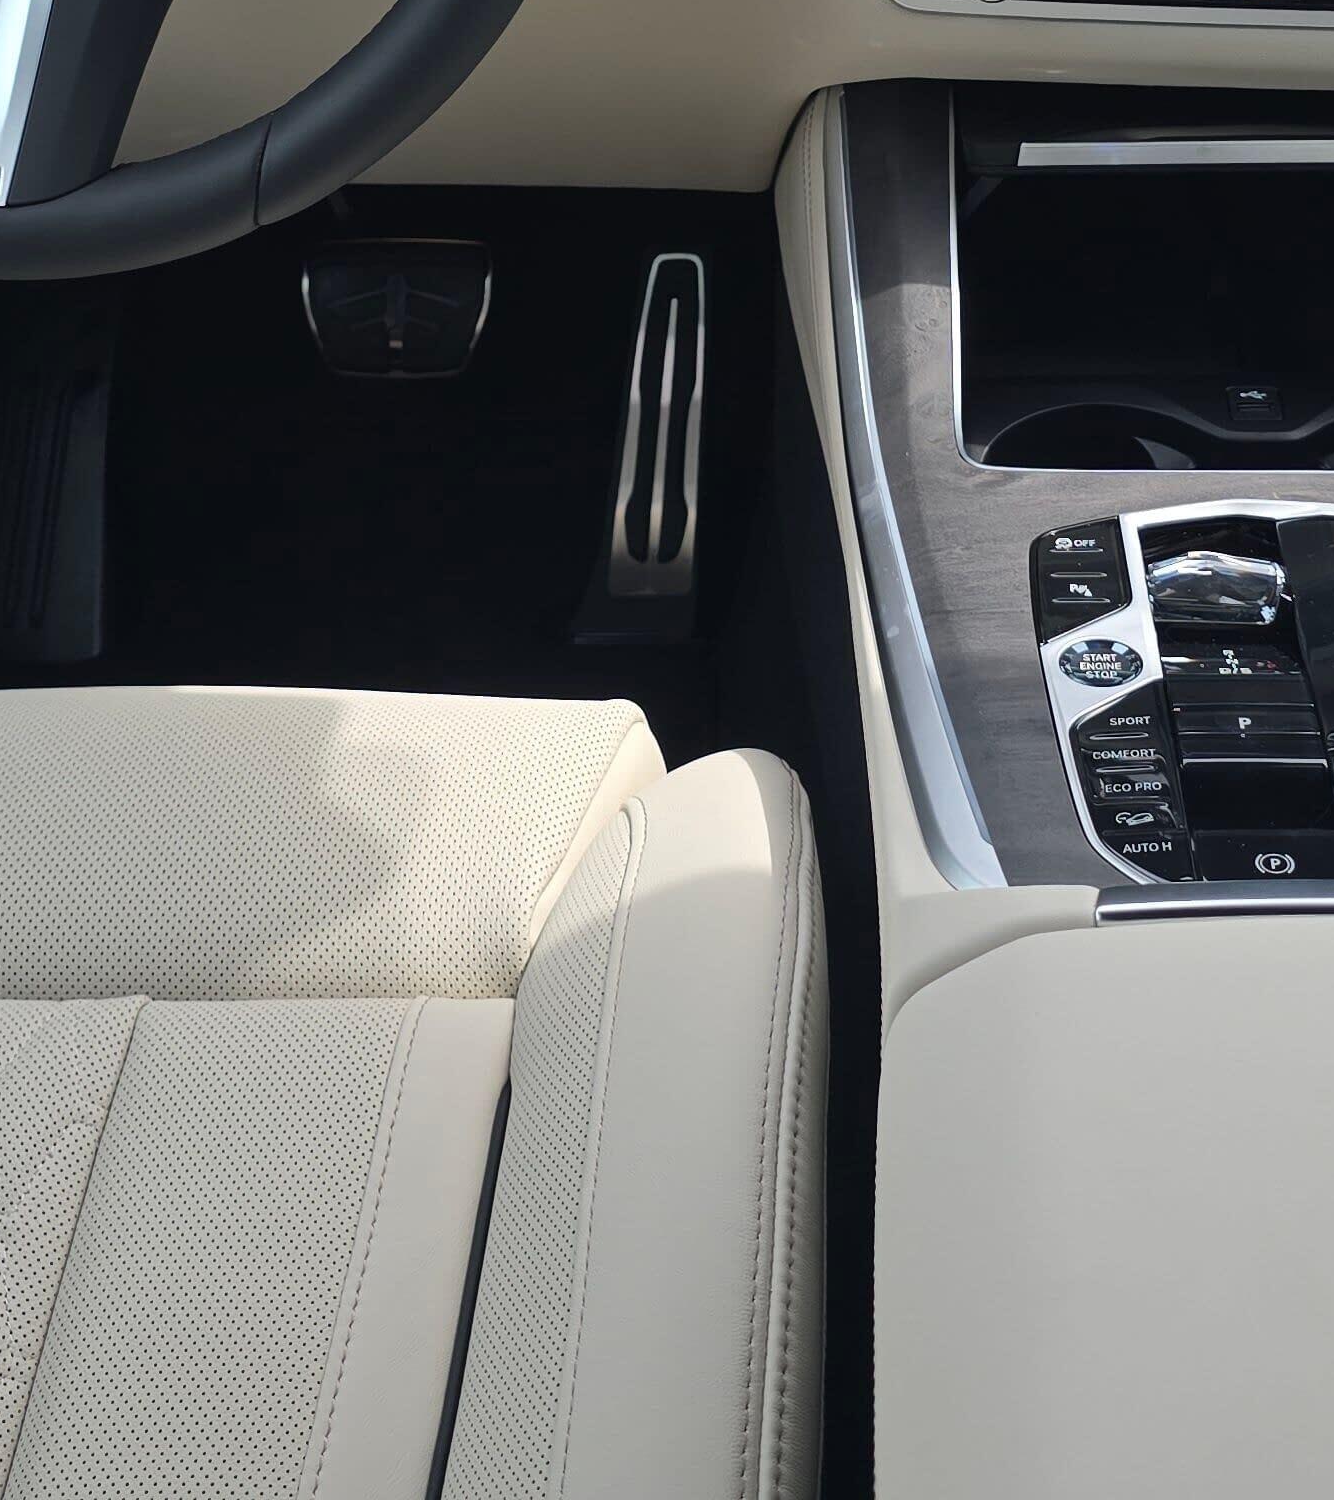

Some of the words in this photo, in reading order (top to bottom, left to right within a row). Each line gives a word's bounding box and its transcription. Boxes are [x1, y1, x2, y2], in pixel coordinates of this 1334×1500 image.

[1073, 539, 1096, 547] OFF
[1083, 653, 1117, 662] START
[1079, 661, 1122, 670] ENGINE
[1085, 670, 1117, 679] STOP
[1109, 716, 1151, 727] SPORT
[1238, 717, 1251, 729] P
[1092, 748, 1156, 760] COMFORT
[1105, 783, 1131, 793] ECO
[1135, 781, 1162, 792] PRO
[1123, 843, 1159, 854] AUTO
[1162, 841, 1172, 851] H
